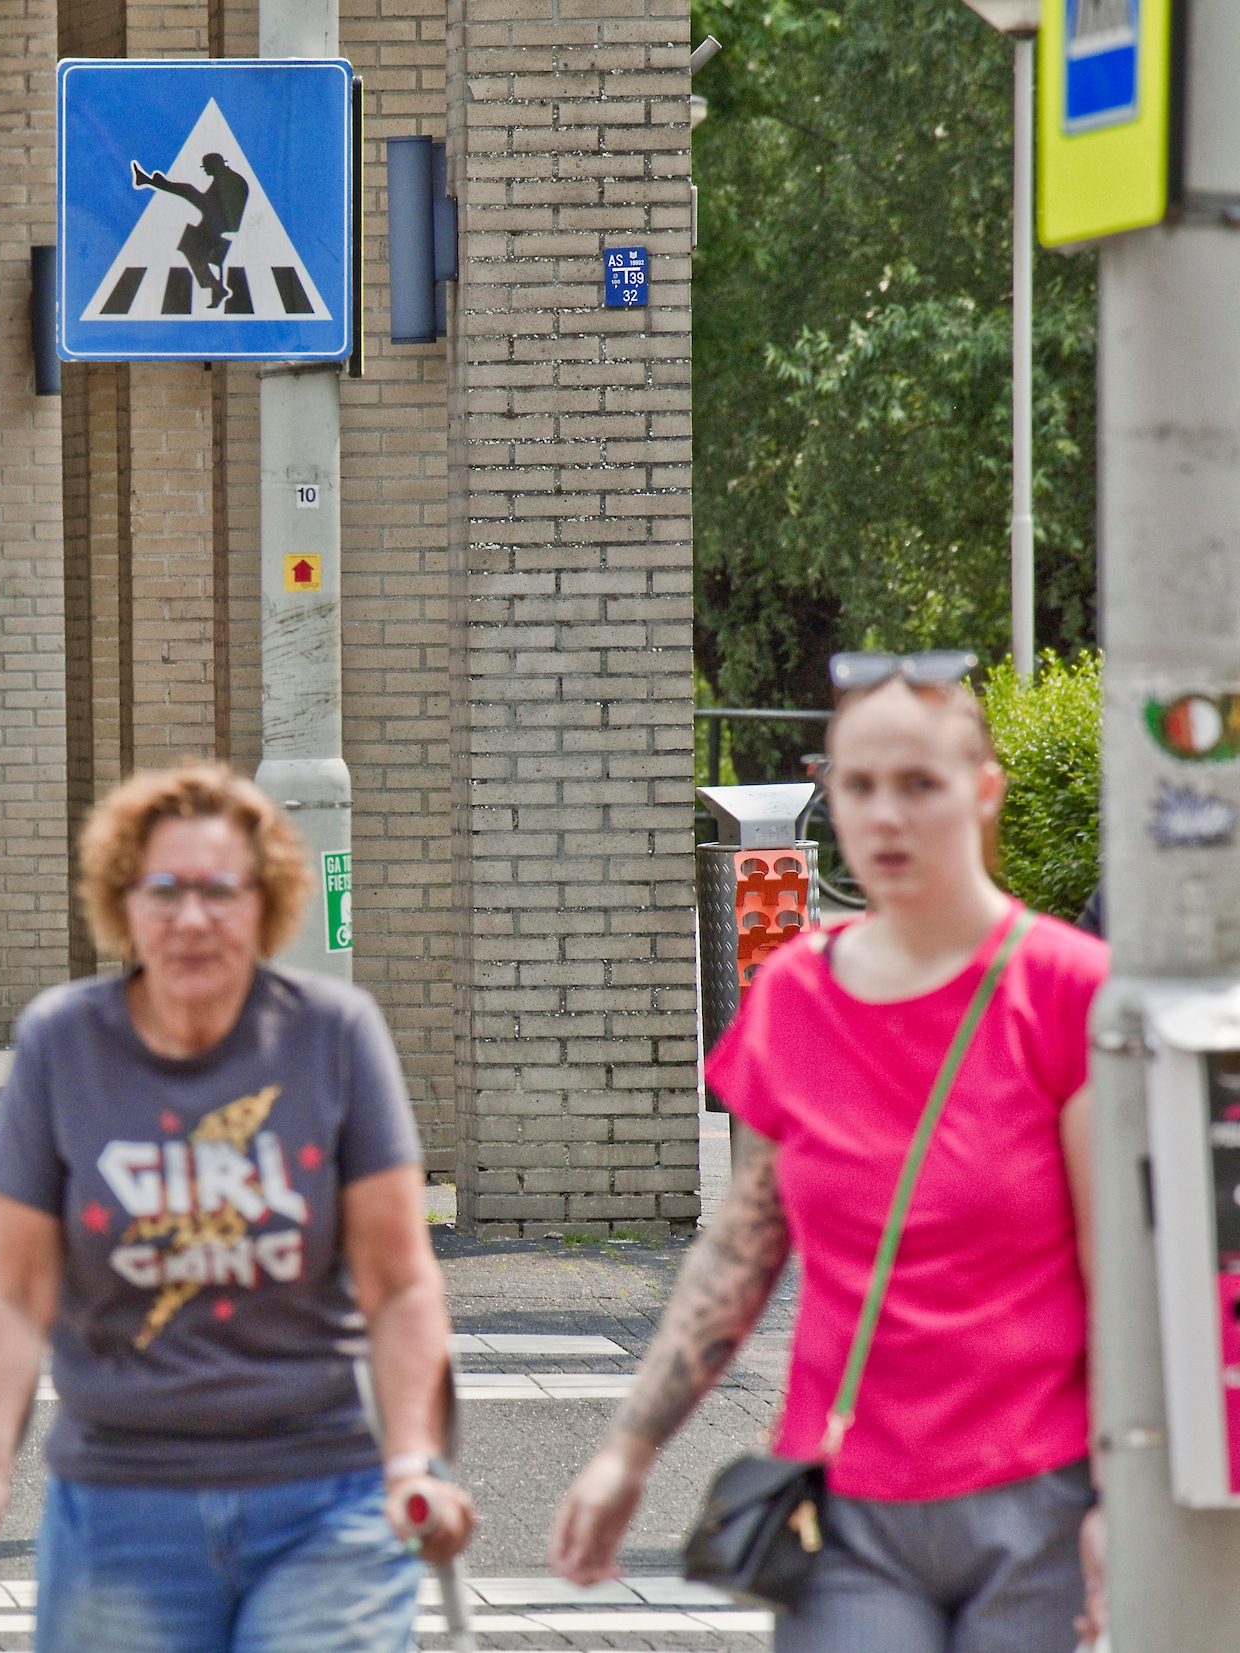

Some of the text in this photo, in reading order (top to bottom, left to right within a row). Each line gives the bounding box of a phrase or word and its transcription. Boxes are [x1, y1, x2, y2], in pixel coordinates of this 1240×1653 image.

[608, 254, 623, 266] AS
[297, 487, 316, 502] 10
[326, 856, 342, 875] GA
[97, 1130, 309, 1225] GIRL
[110, 1230, 304, 1291] GANG
